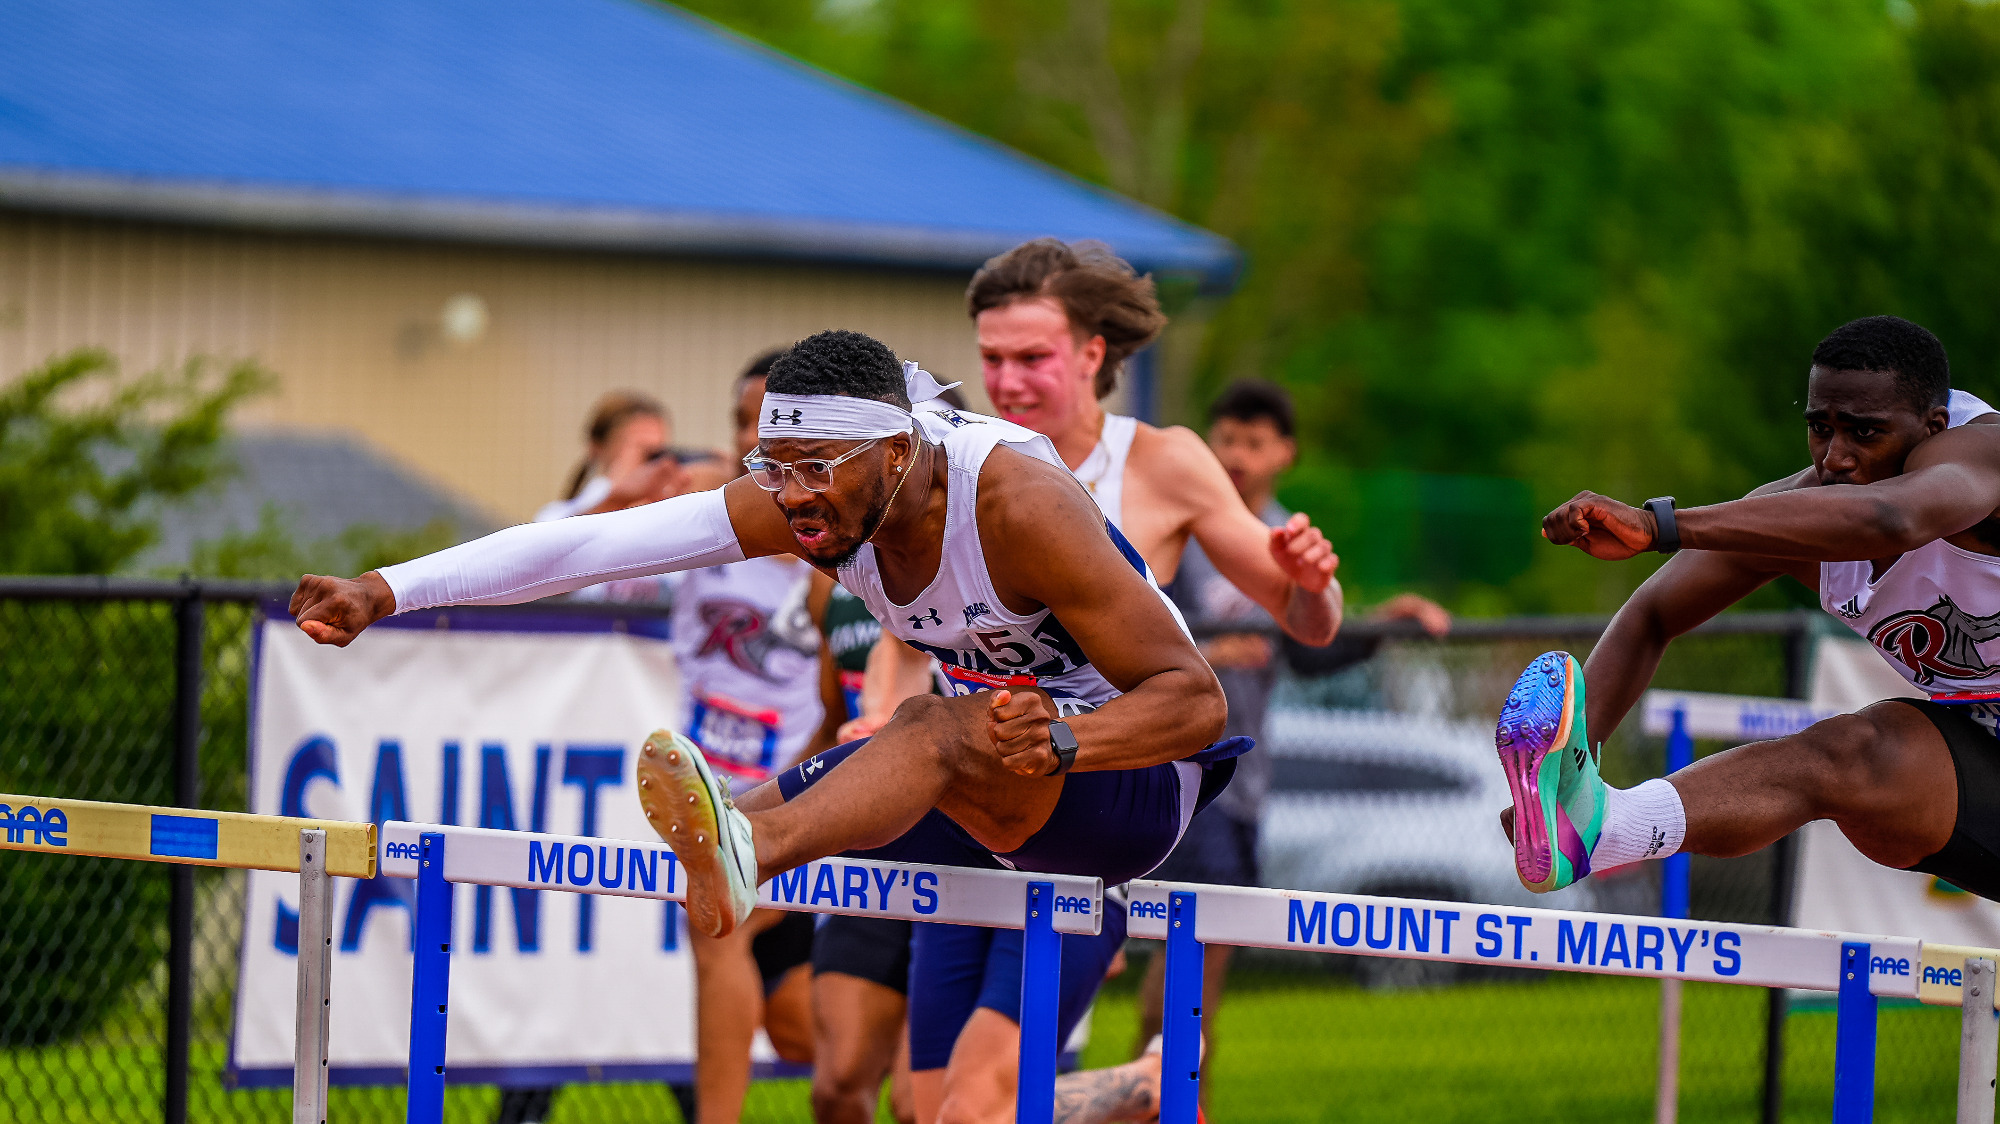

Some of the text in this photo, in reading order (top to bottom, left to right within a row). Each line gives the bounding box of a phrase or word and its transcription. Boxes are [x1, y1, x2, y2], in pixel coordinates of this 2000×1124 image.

[976, 629, 1036, 668] 5
[528, 841, 938, 914] MOUNT MARY'S
[1287, 899, 1742, 976] MOUNT ST. MARY'S
